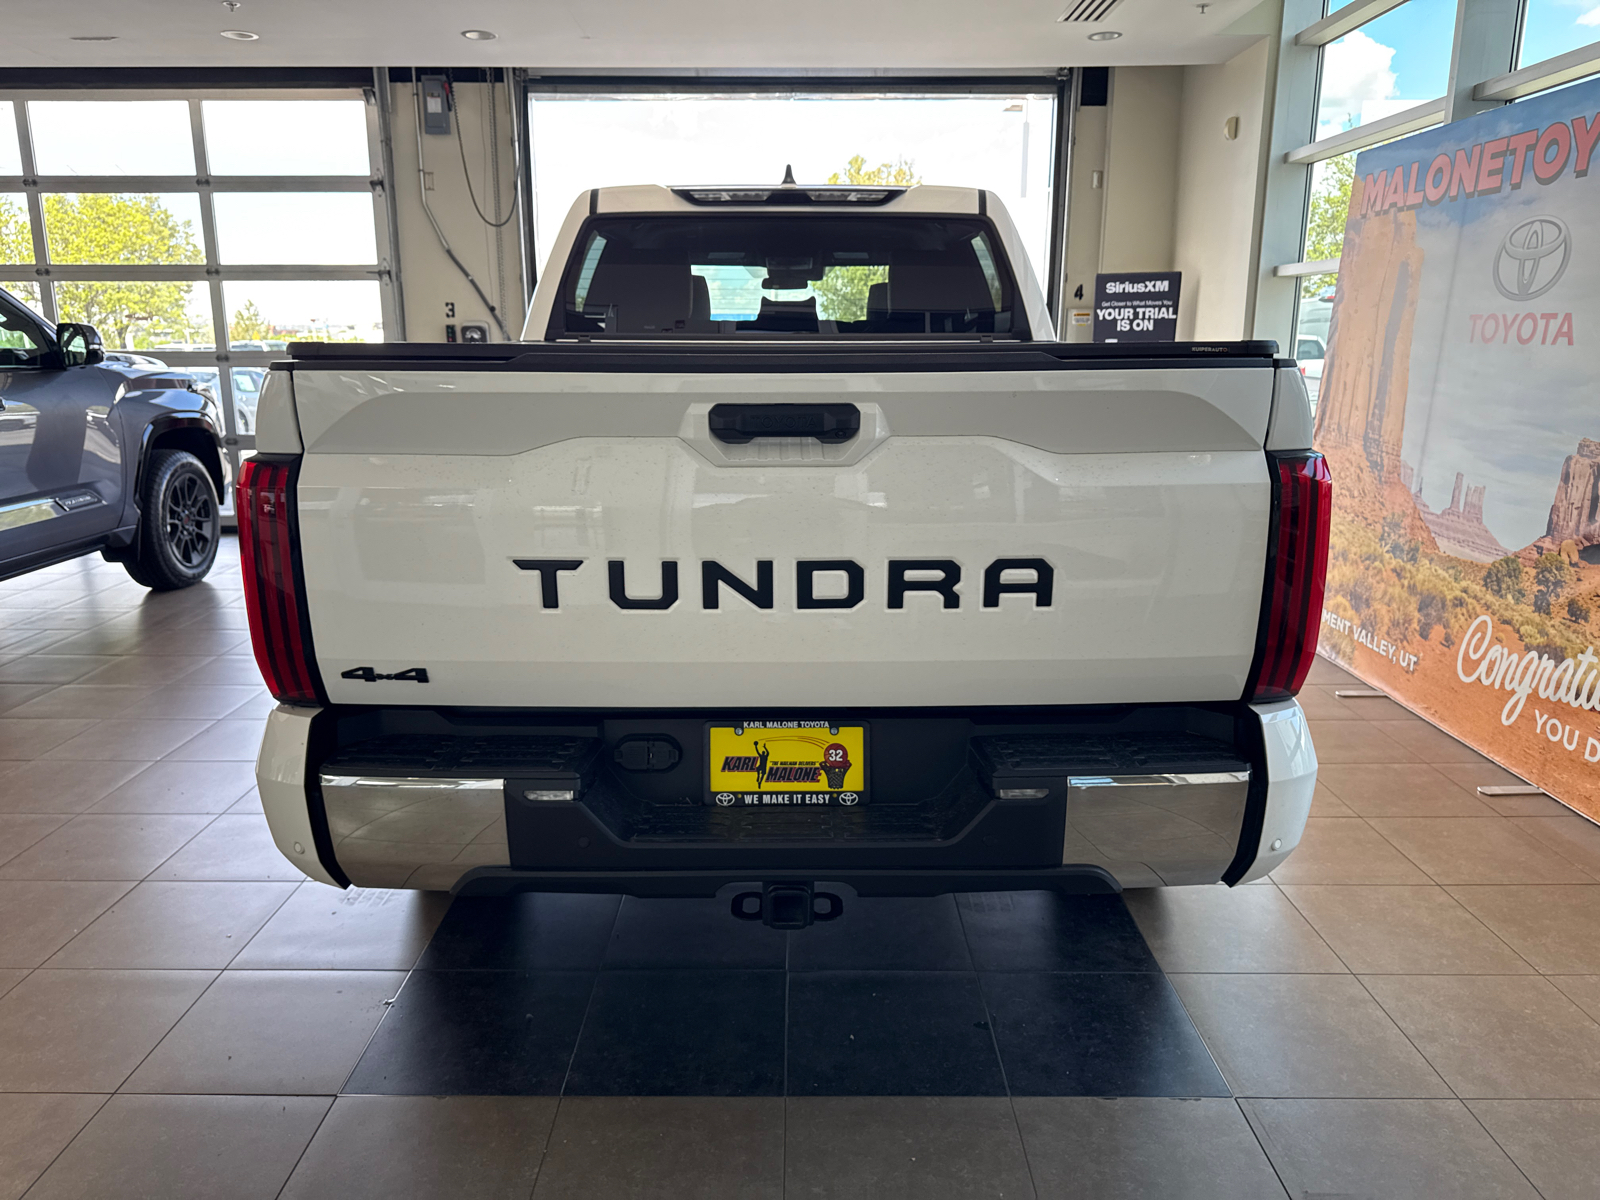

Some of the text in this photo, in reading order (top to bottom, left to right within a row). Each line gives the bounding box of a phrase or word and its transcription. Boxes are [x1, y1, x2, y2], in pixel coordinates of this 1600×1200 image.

[1074, 284, 1084, 301] 4
[1105, 280, 1169, 294] SiriusXM
[445, 302, 455, 318] 3
[1096, 307, 1134, 320] YOUR
[1136, 307, 1177, 319] TRIAL
[1117, 319, 1154, 331] IS ON
[1469, 312, 1574, 346] TOYOTA
[750, 415, 817, 428] TOYOTA
[510, 558, 1055, 610] TUNDRA
[1353, 625, 1396, 664] VALLEY,
[1400, 650, 1417, 671] UT
[1535, 709, 1579, 751] YOU
[828, 749, 843, 761] 32
[721, 756, 759, 772] KARL
[765, 767, 822, 783] MALONE
[744, 794, 830, 804] WE MAKE IT EASY
